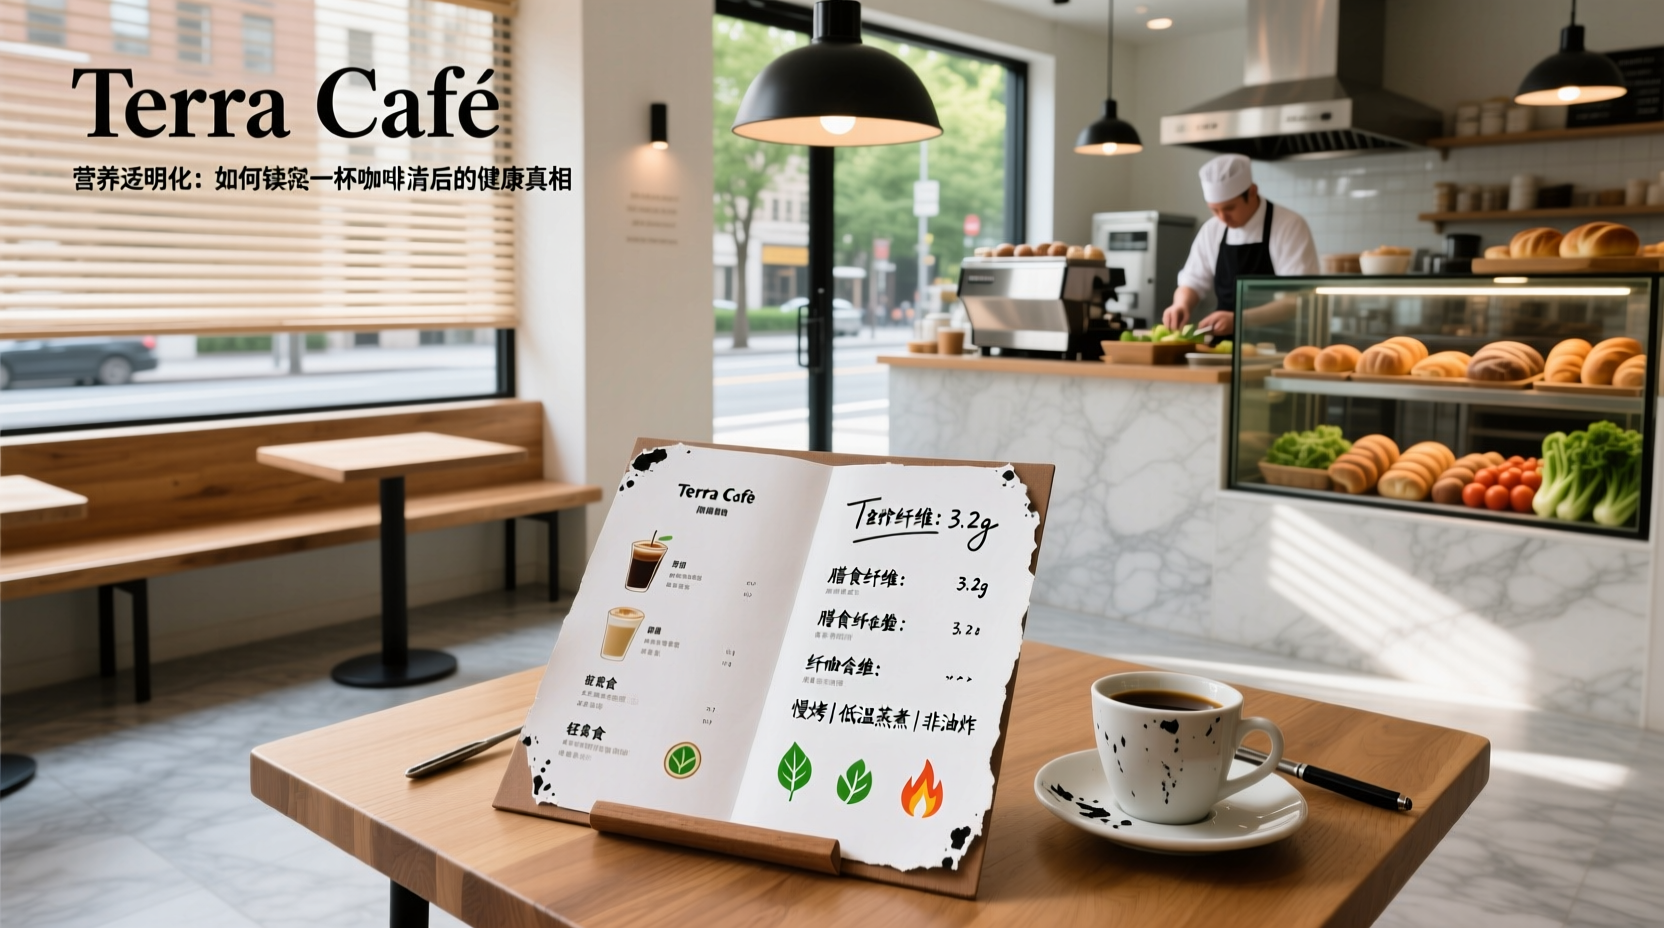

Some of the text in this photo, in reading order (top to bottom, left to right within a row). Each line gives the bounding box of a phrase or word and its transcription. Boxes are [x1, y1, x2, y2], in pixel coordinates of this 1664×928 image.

[678, 483, 719, 501] Terra
[947, 508, 999, 552] 3.2g
[956, 576, 989, 599] 3.2g
